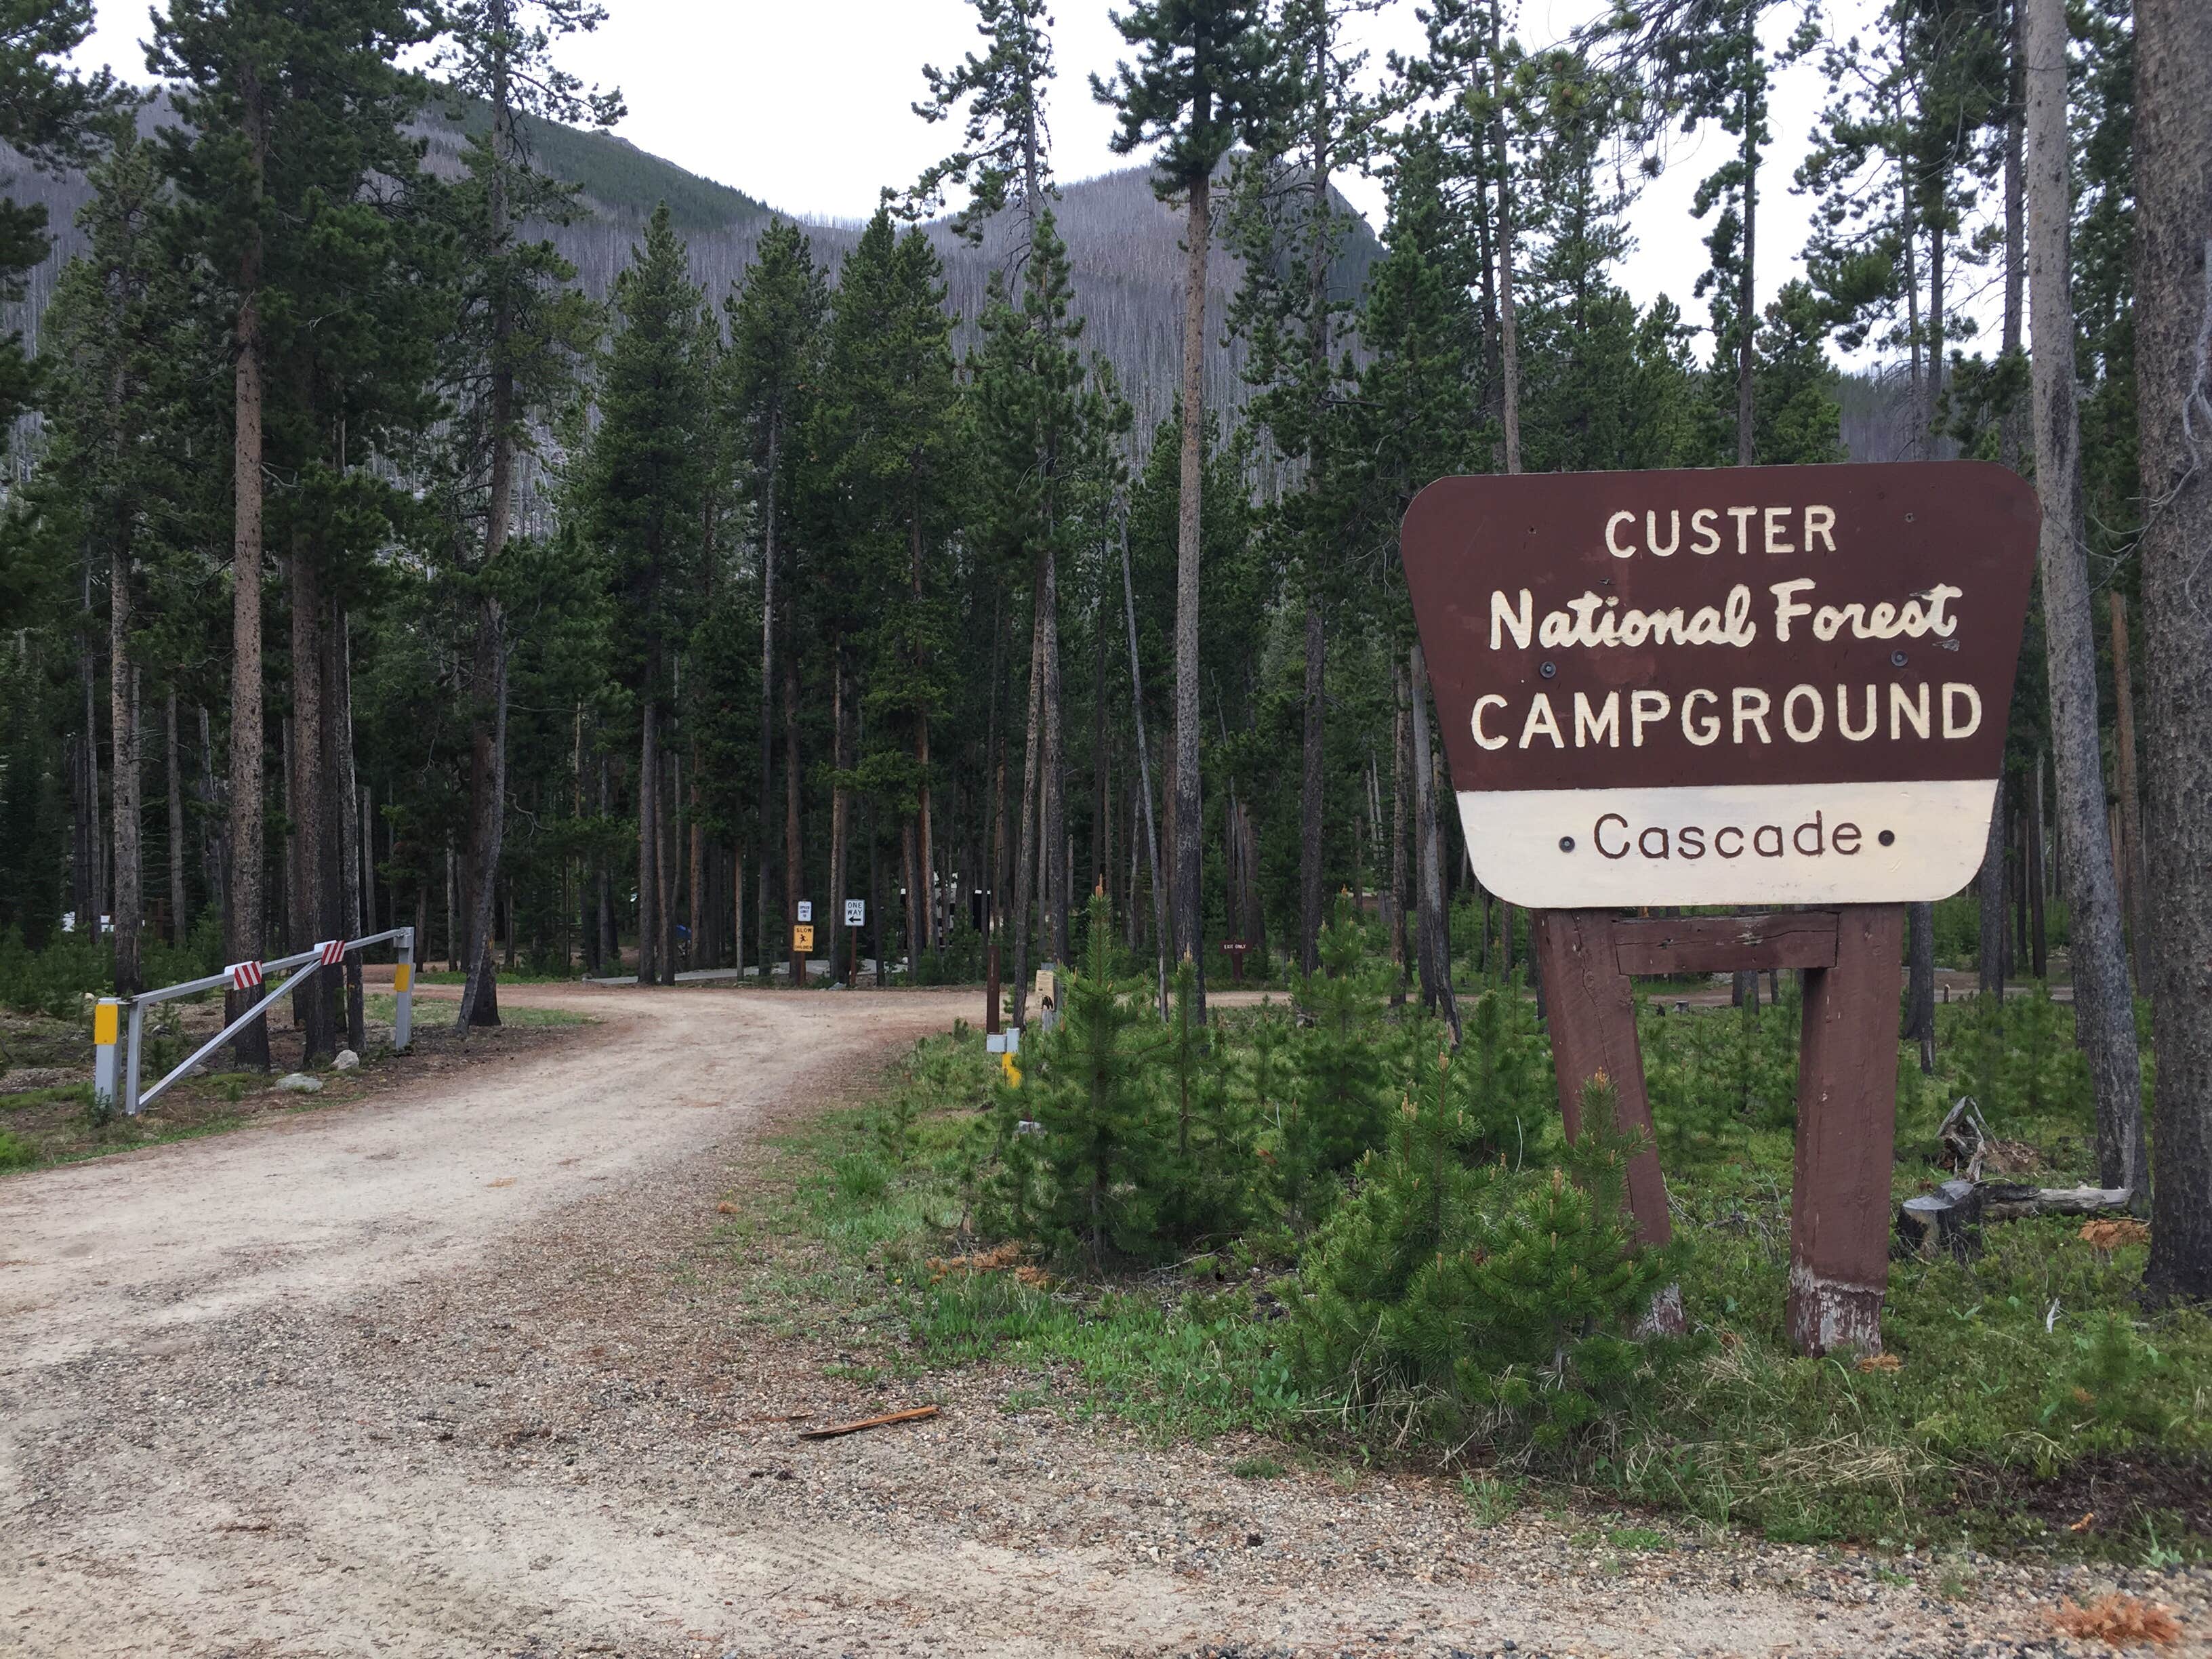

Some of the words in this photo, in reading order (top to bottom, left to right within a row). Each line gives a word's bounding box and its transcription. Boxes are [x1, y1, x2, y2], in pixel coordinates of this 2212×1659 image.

[1605, 505, 1837, 558] CUSTER
[1490, 583, 1756, 650] National
[1769, 578, 1963, 642] Forest
[1471, 682, 1982, 750] CAMPGROUND
[1593, 810, 1862, 860] Cascade
